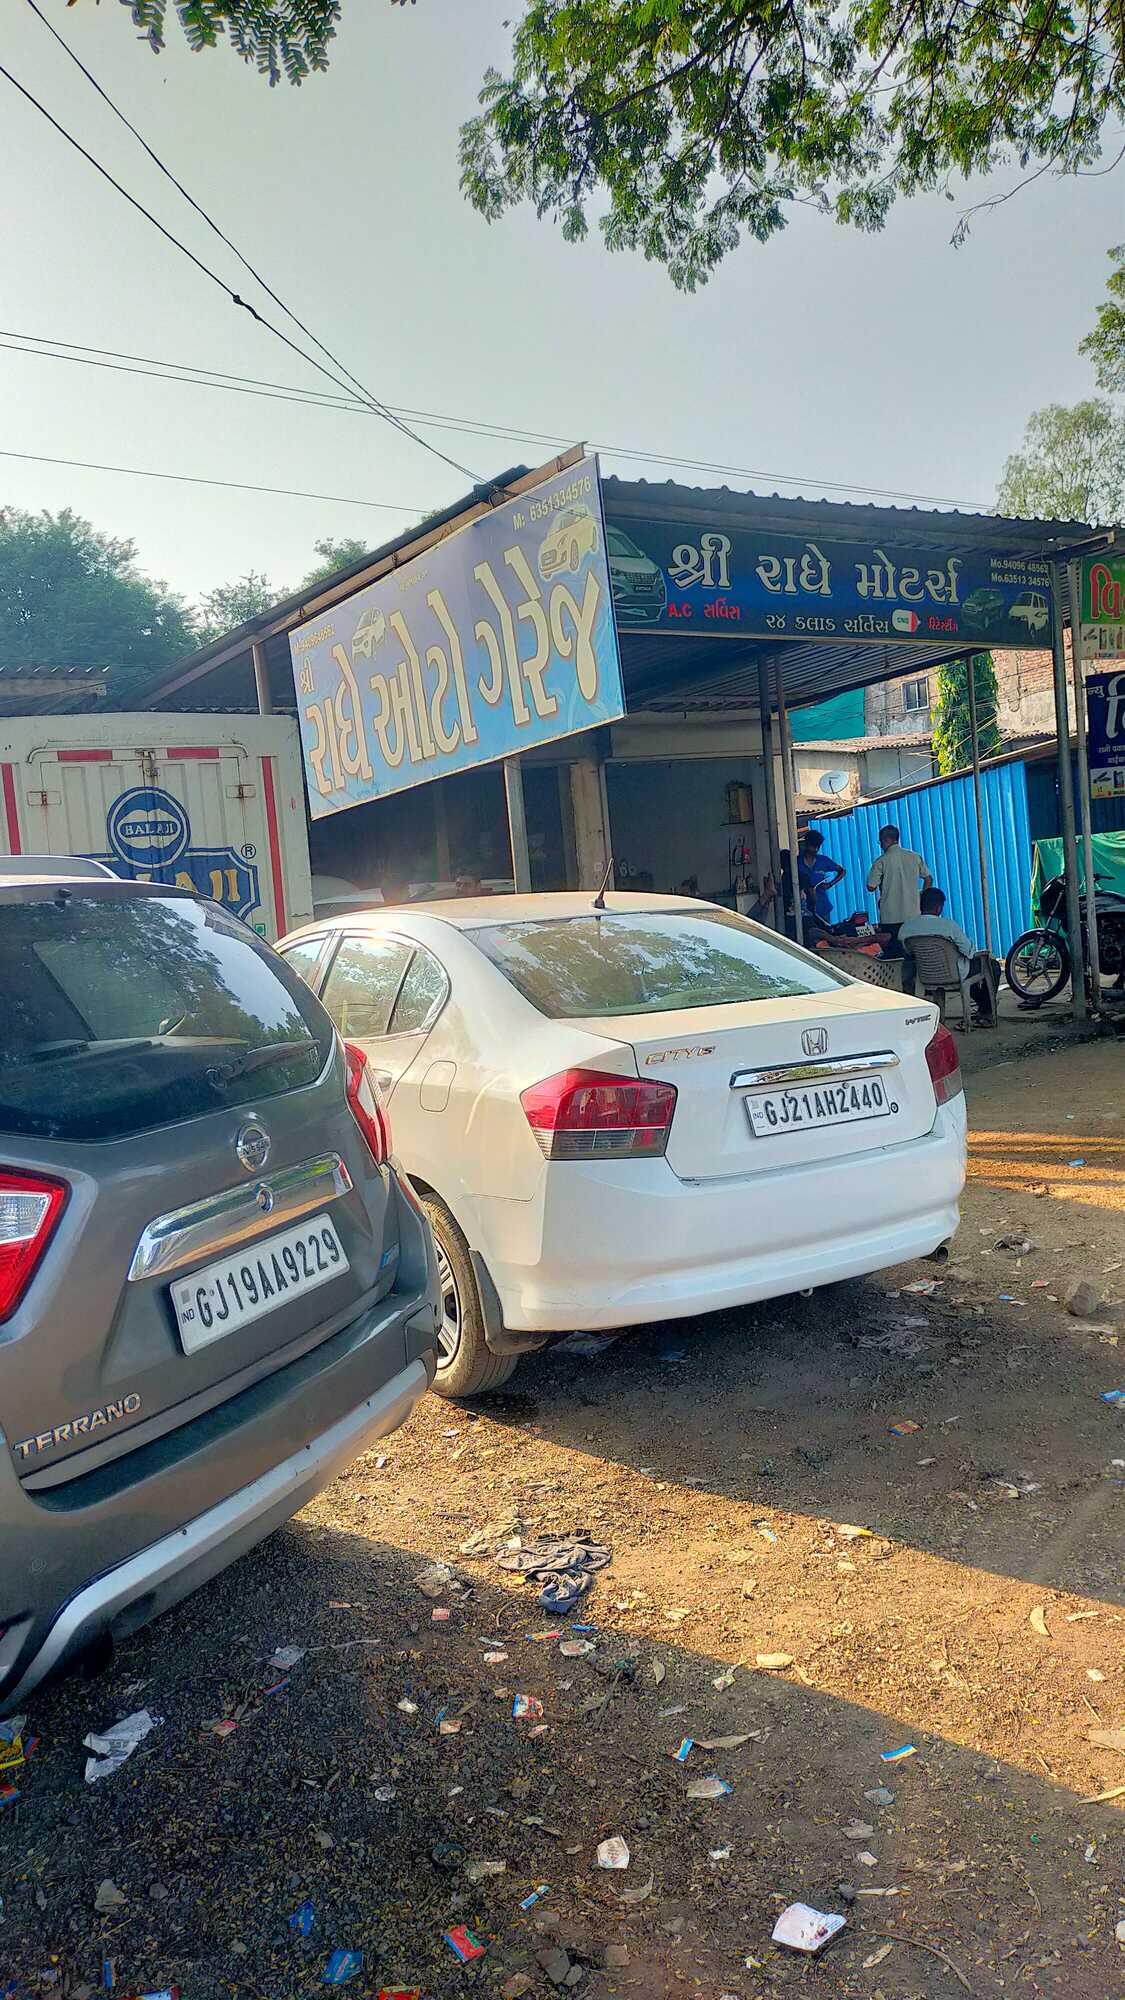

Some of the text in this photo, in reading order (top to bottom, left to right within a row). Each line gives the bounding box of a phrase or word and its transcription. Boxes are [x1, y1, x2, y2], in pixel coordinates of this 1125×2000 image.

[529, 475, 592, 521] 6351334576
[668, 533, 962, 604] શ્રી રાધે મોટર્સ
[794, 616, 836, 631] કલાક
[843, 614, 889, 633] સર્વિસ
[305, 545, 601, 793] રાધે ઓટો ગેરેજ
[124, 824, 175, 837] BALAJI
[765, 1082, 884, 1126] GJ21AH2440
[196, 1228, 340, 1328] GJ19AA9229
[181, 1308, 195, 1324] IND
[13, 1392, 142, 1460] TERRANO
